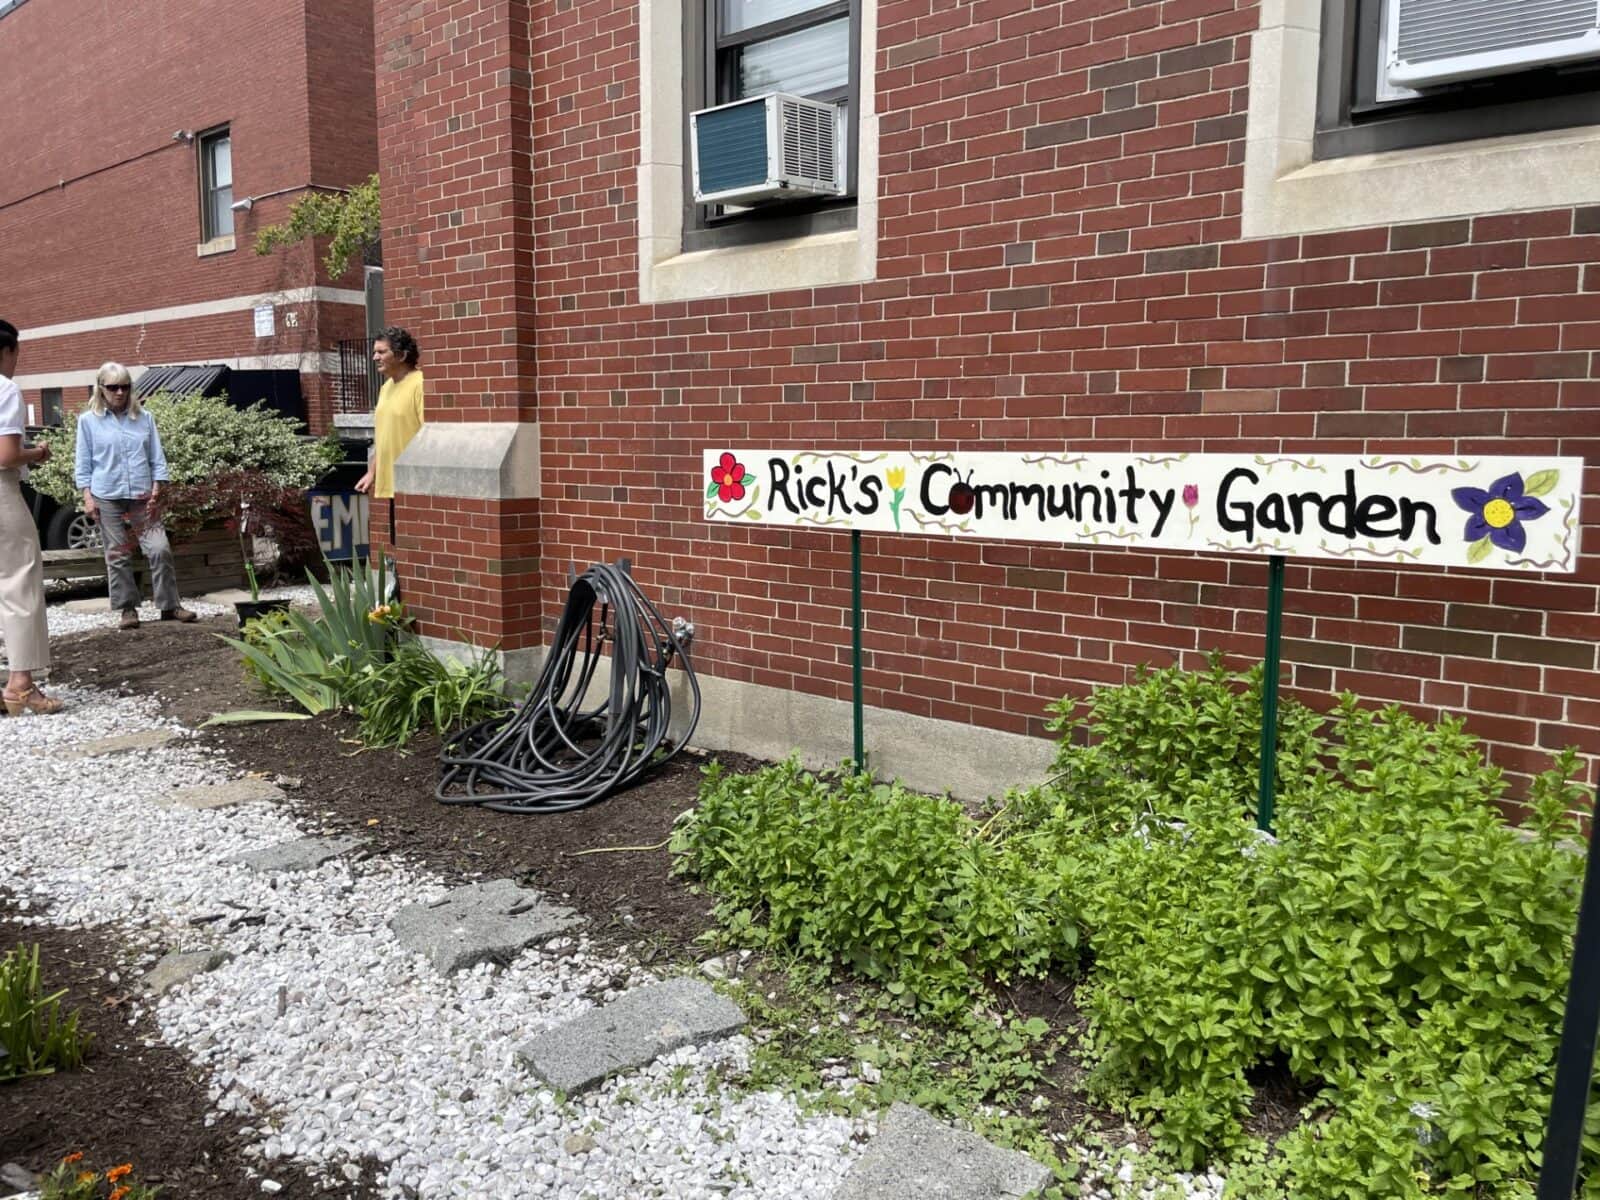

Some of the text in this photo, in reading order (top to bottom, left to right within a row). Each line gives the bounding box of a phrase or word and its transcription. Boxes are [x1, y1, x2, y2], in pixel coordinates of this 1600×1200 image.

[768, 457, 1441, 545] Rick's Community Garden
